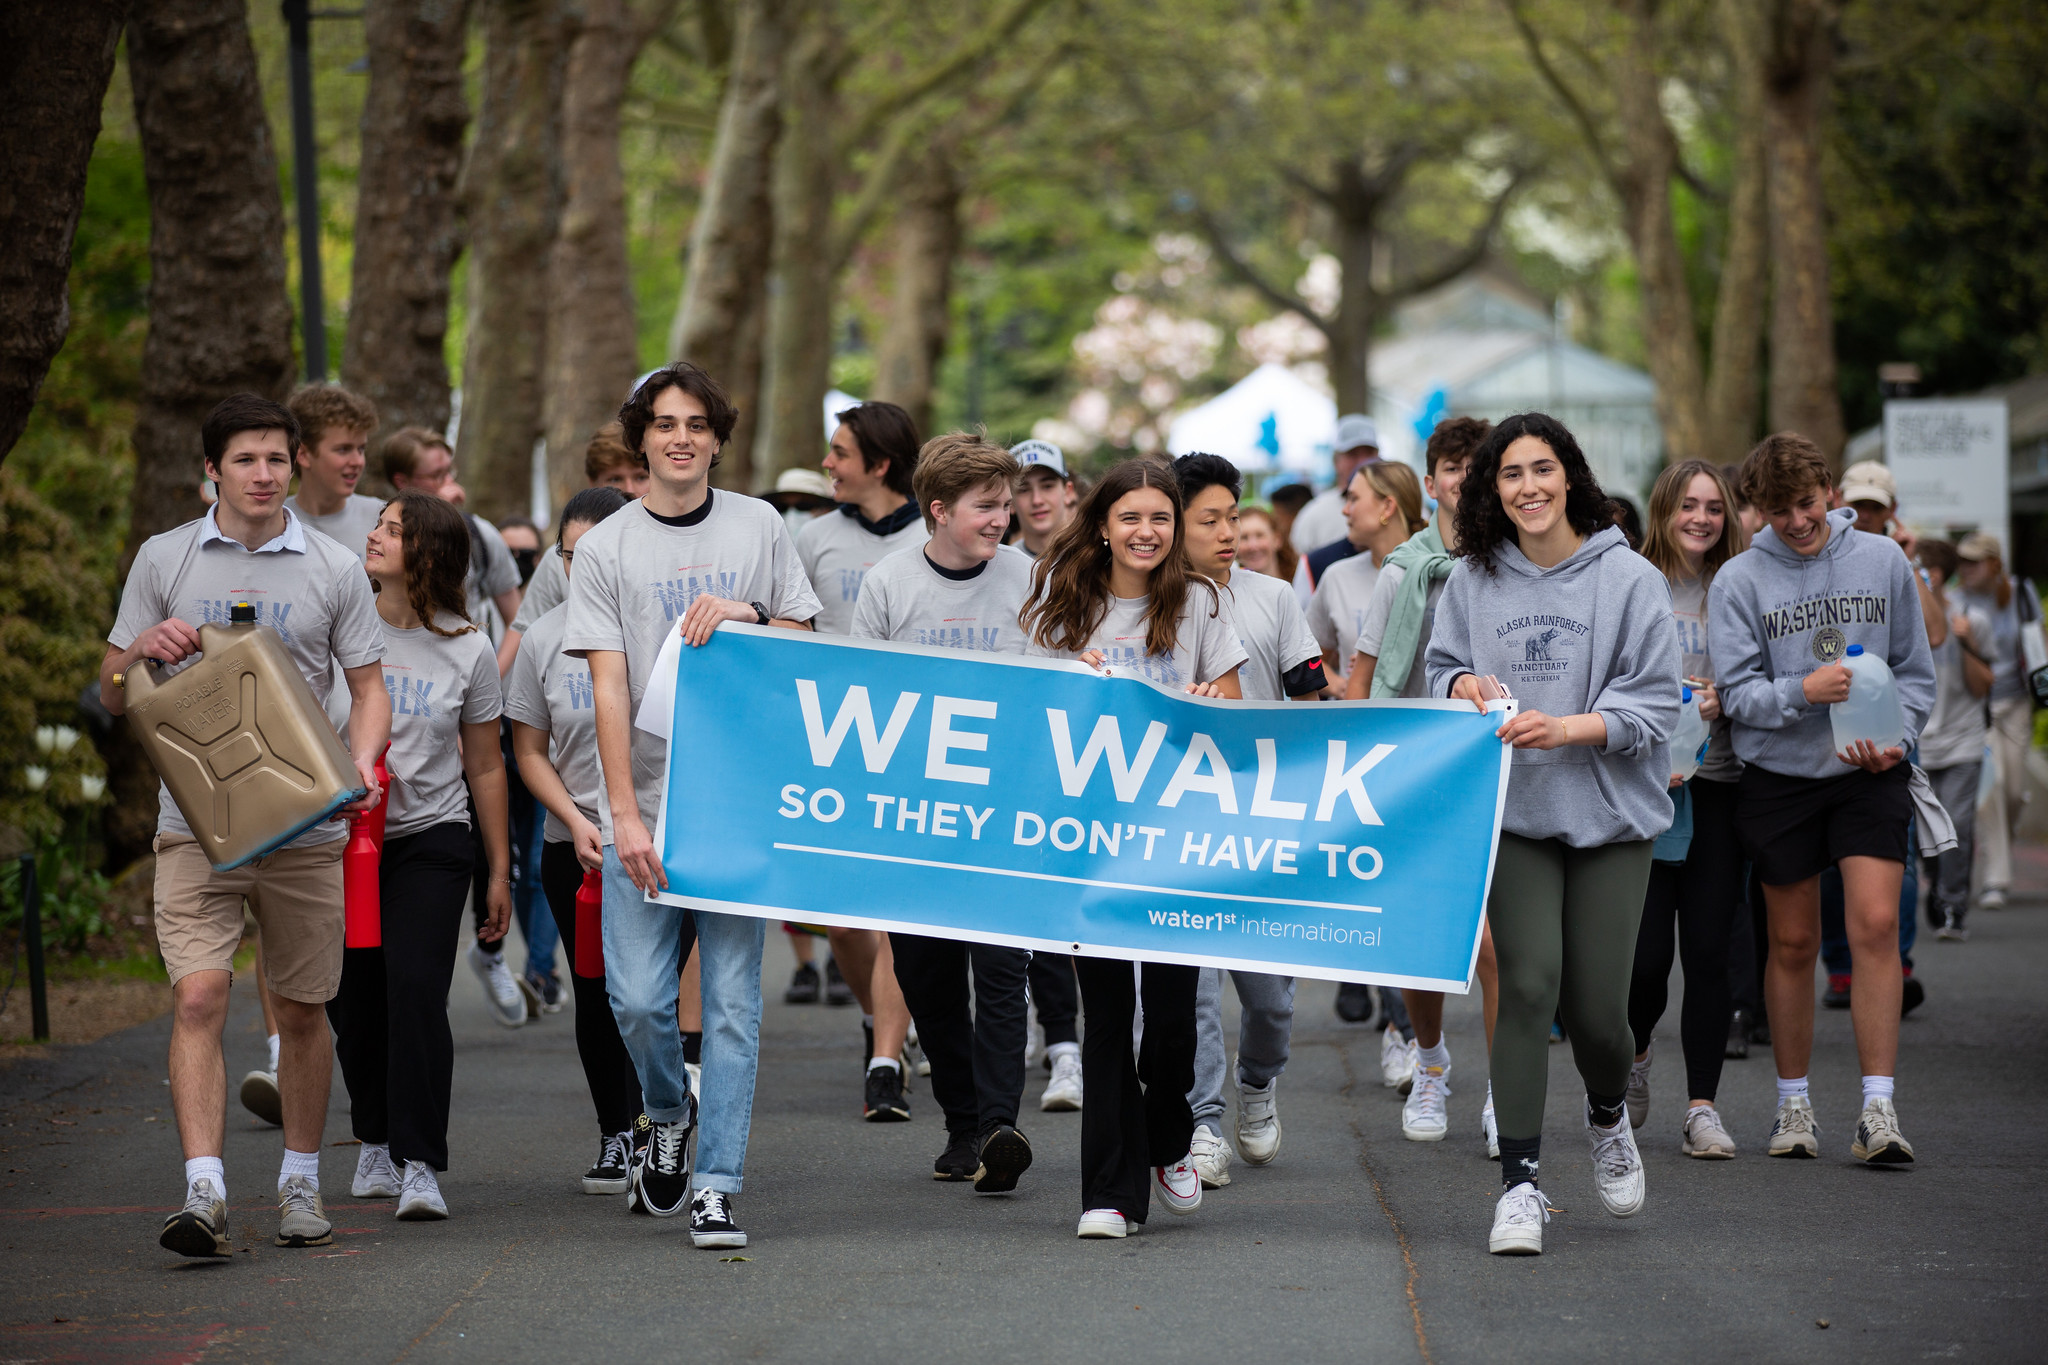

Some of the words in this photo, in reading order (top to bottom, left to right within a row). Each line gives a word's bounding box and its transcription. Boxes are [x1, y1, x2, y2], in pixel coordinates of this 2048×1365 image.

[1495, 616, 1531, 639] ALASKA
[1533, 615, 1589, 636] RAINFOREST
[1762, 597, 1887, 640] WASHINGTON
[1511, 662, 1568, 672] SANCTUARY
[1521, 674, 1560, 683] KETCHIKAN
[1781, 667, 1816, 677] SCHOOL
[174, 677, 224, 713] POTABLE
[183, 696, 236, 735] WATER
[795, 678, 998, 786] WE
[1046, 708, 1398, 826] WALK
[777, 784, 846, 823] SO
[866, 793, 996, 840] THEY
[1013, 811, 1166, 861] DON'T
[1179, 831, 1301, 875] HAVE
[1318, 843, 1384, 880] TO
[1147, 909, 1237, 932] water1st
[1240, 915, 1382, 947] international
